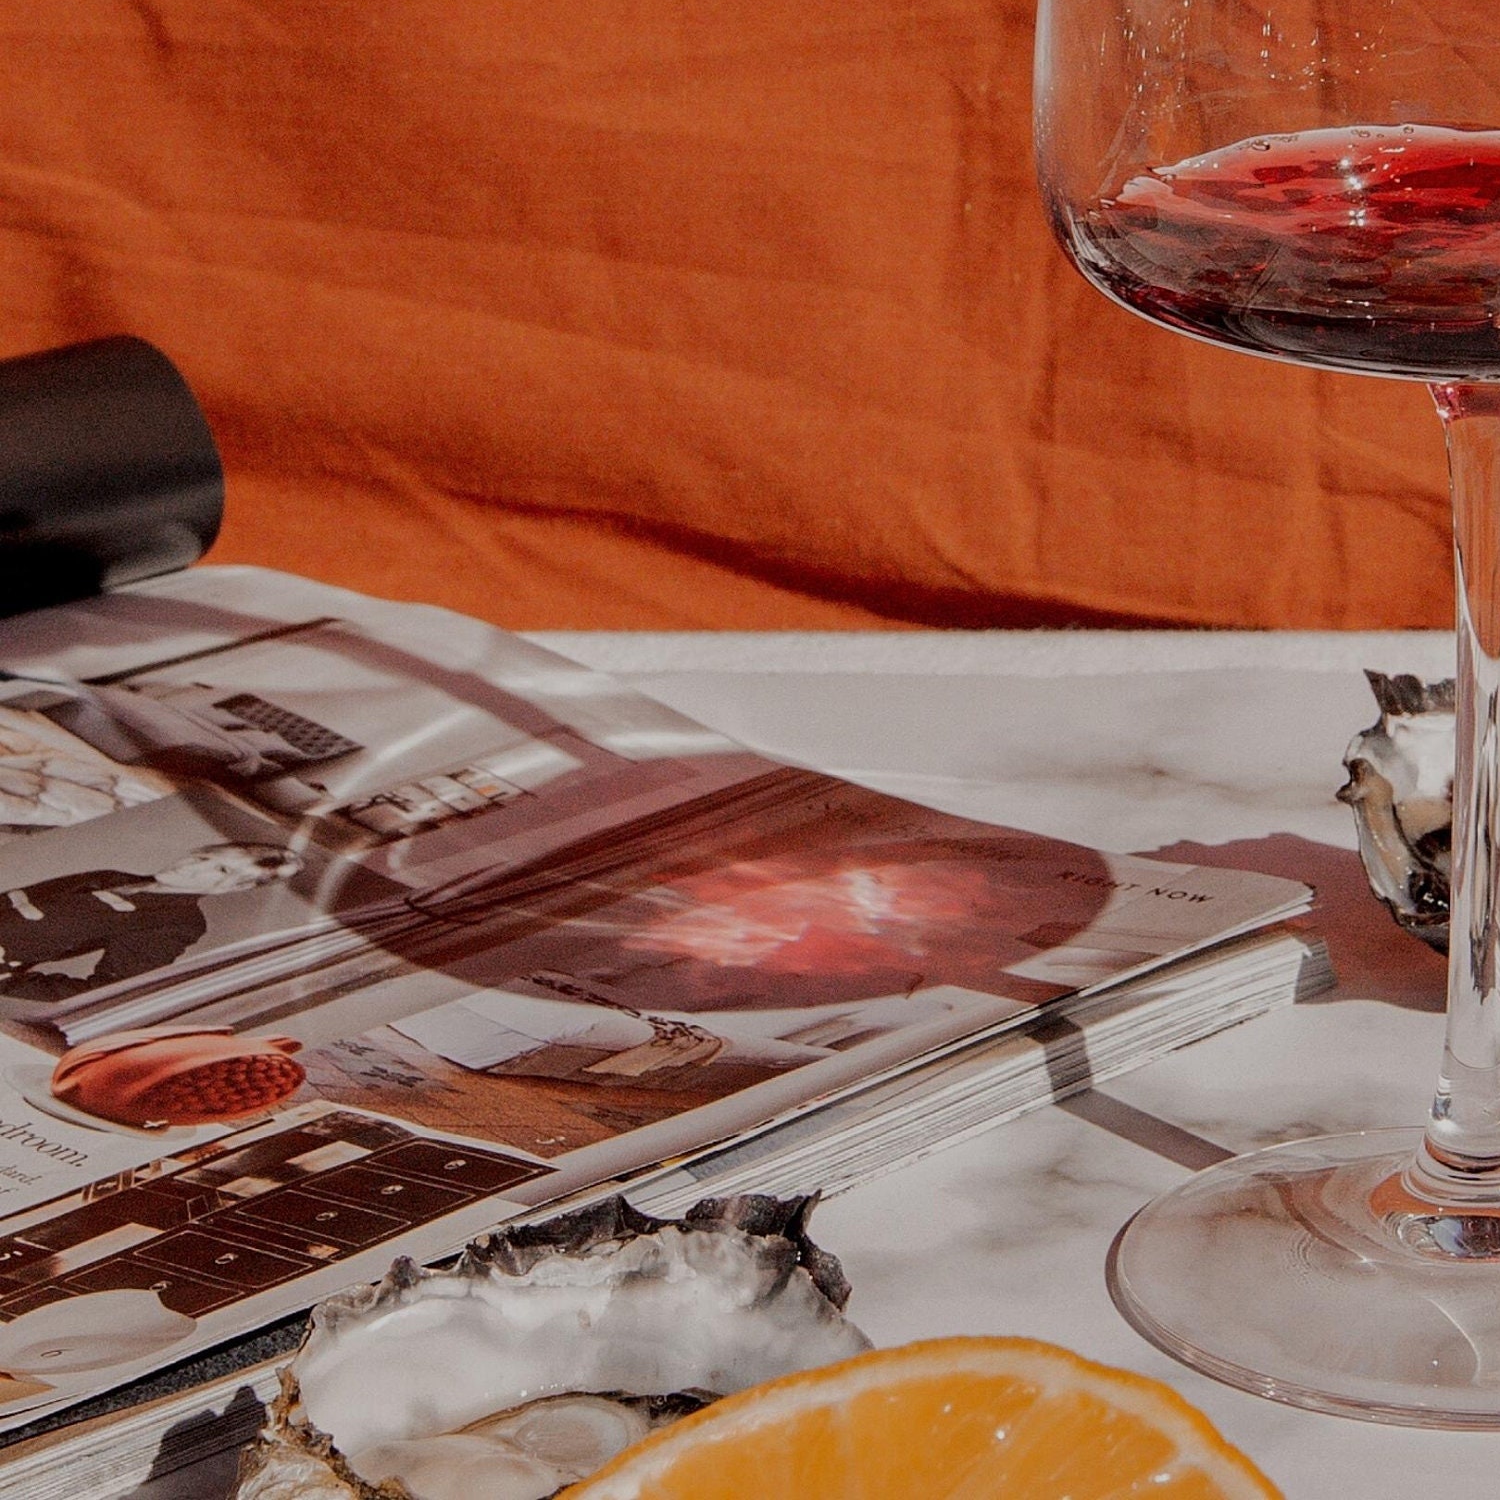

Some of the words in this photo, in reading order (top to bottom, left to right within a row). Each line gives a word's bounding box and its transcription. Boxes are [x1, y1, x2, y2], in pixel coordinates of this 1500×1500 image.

[1057, 870, 1141, 891] RIGHT
[1146, 887, 1214, 904] NOW
[0, 1118, 89, 1167] droom.
